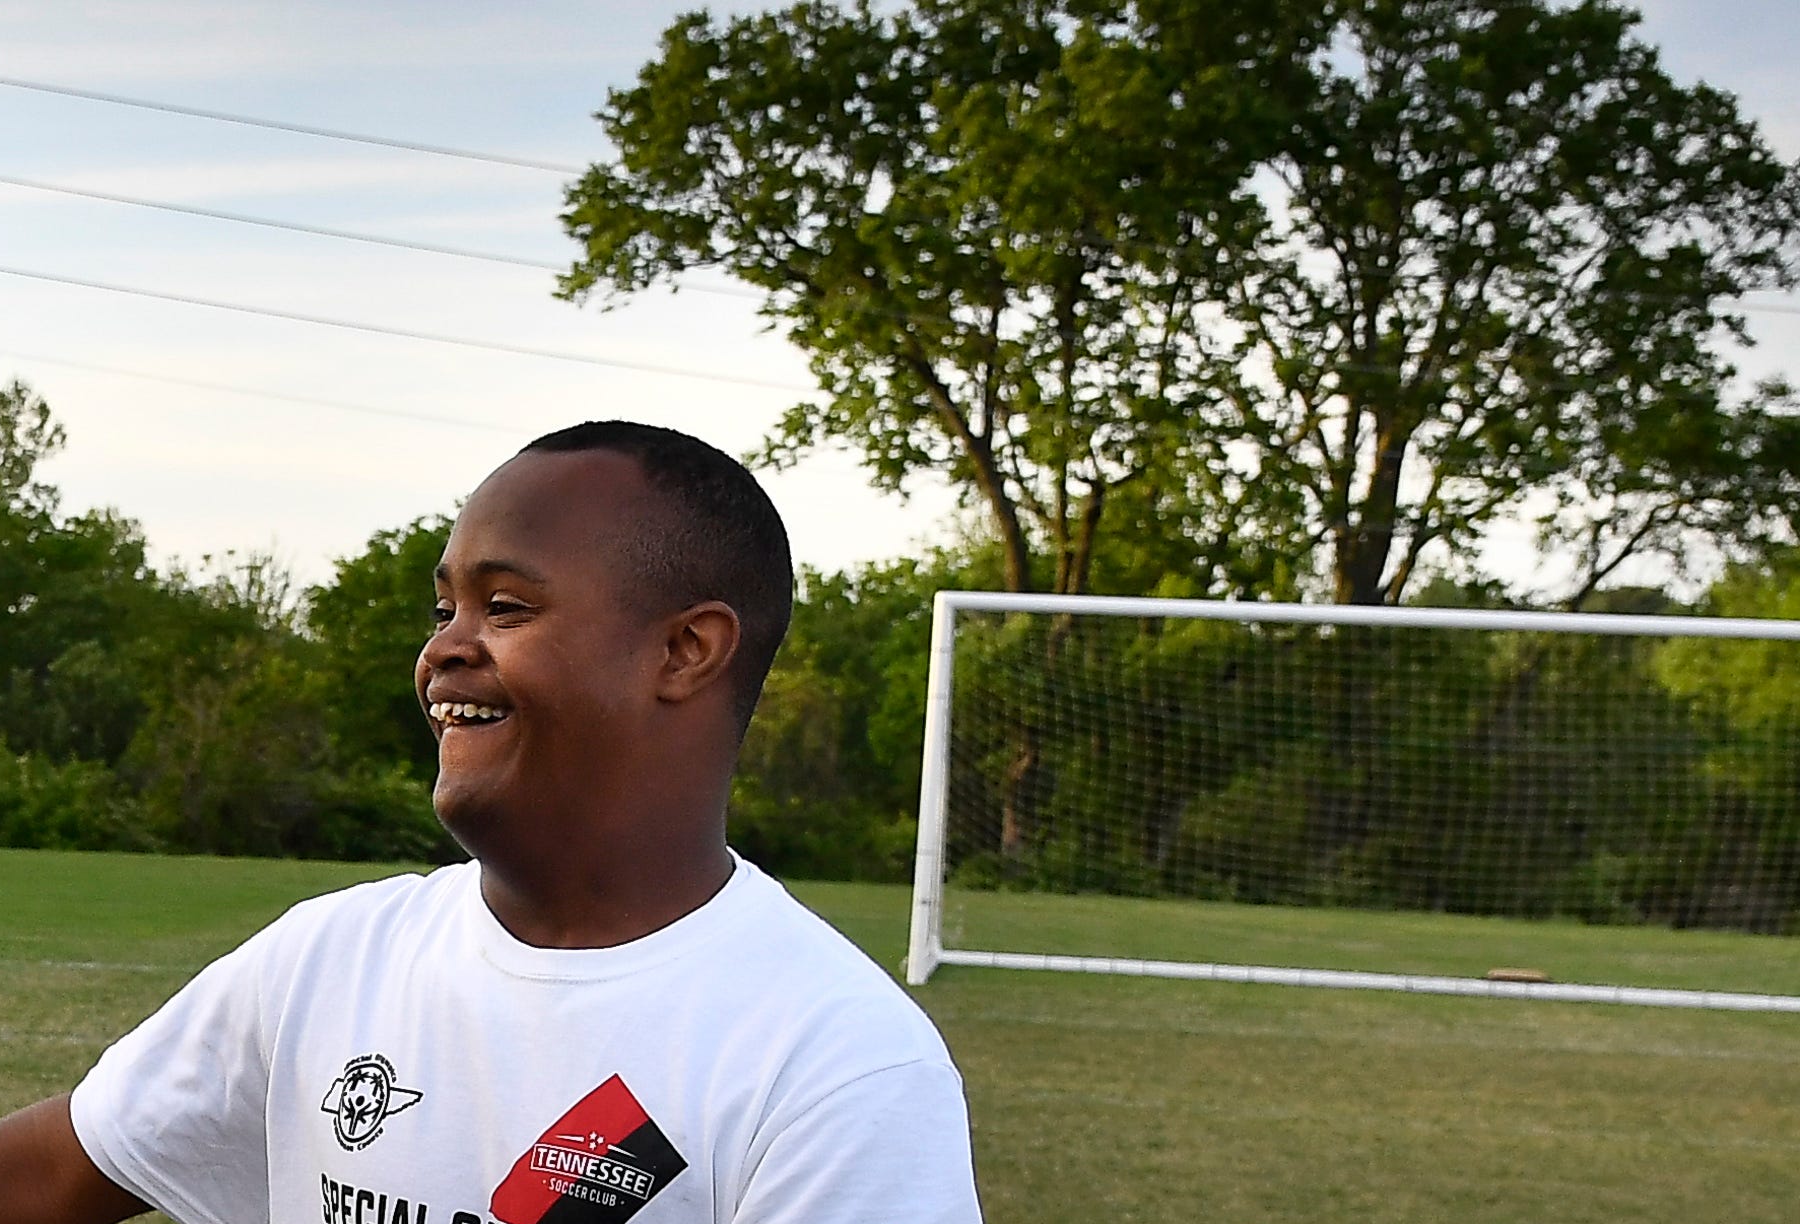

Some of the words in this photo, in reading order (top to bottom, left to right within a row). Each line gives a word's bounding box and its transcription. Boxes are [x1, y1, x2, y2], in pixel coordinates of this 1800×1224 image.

[536, 1147, 649, 1194] TENNESSEE
[548, 1177, 587, 1200] SOCCER
[589, 1188, 617, 1207] CLUB
